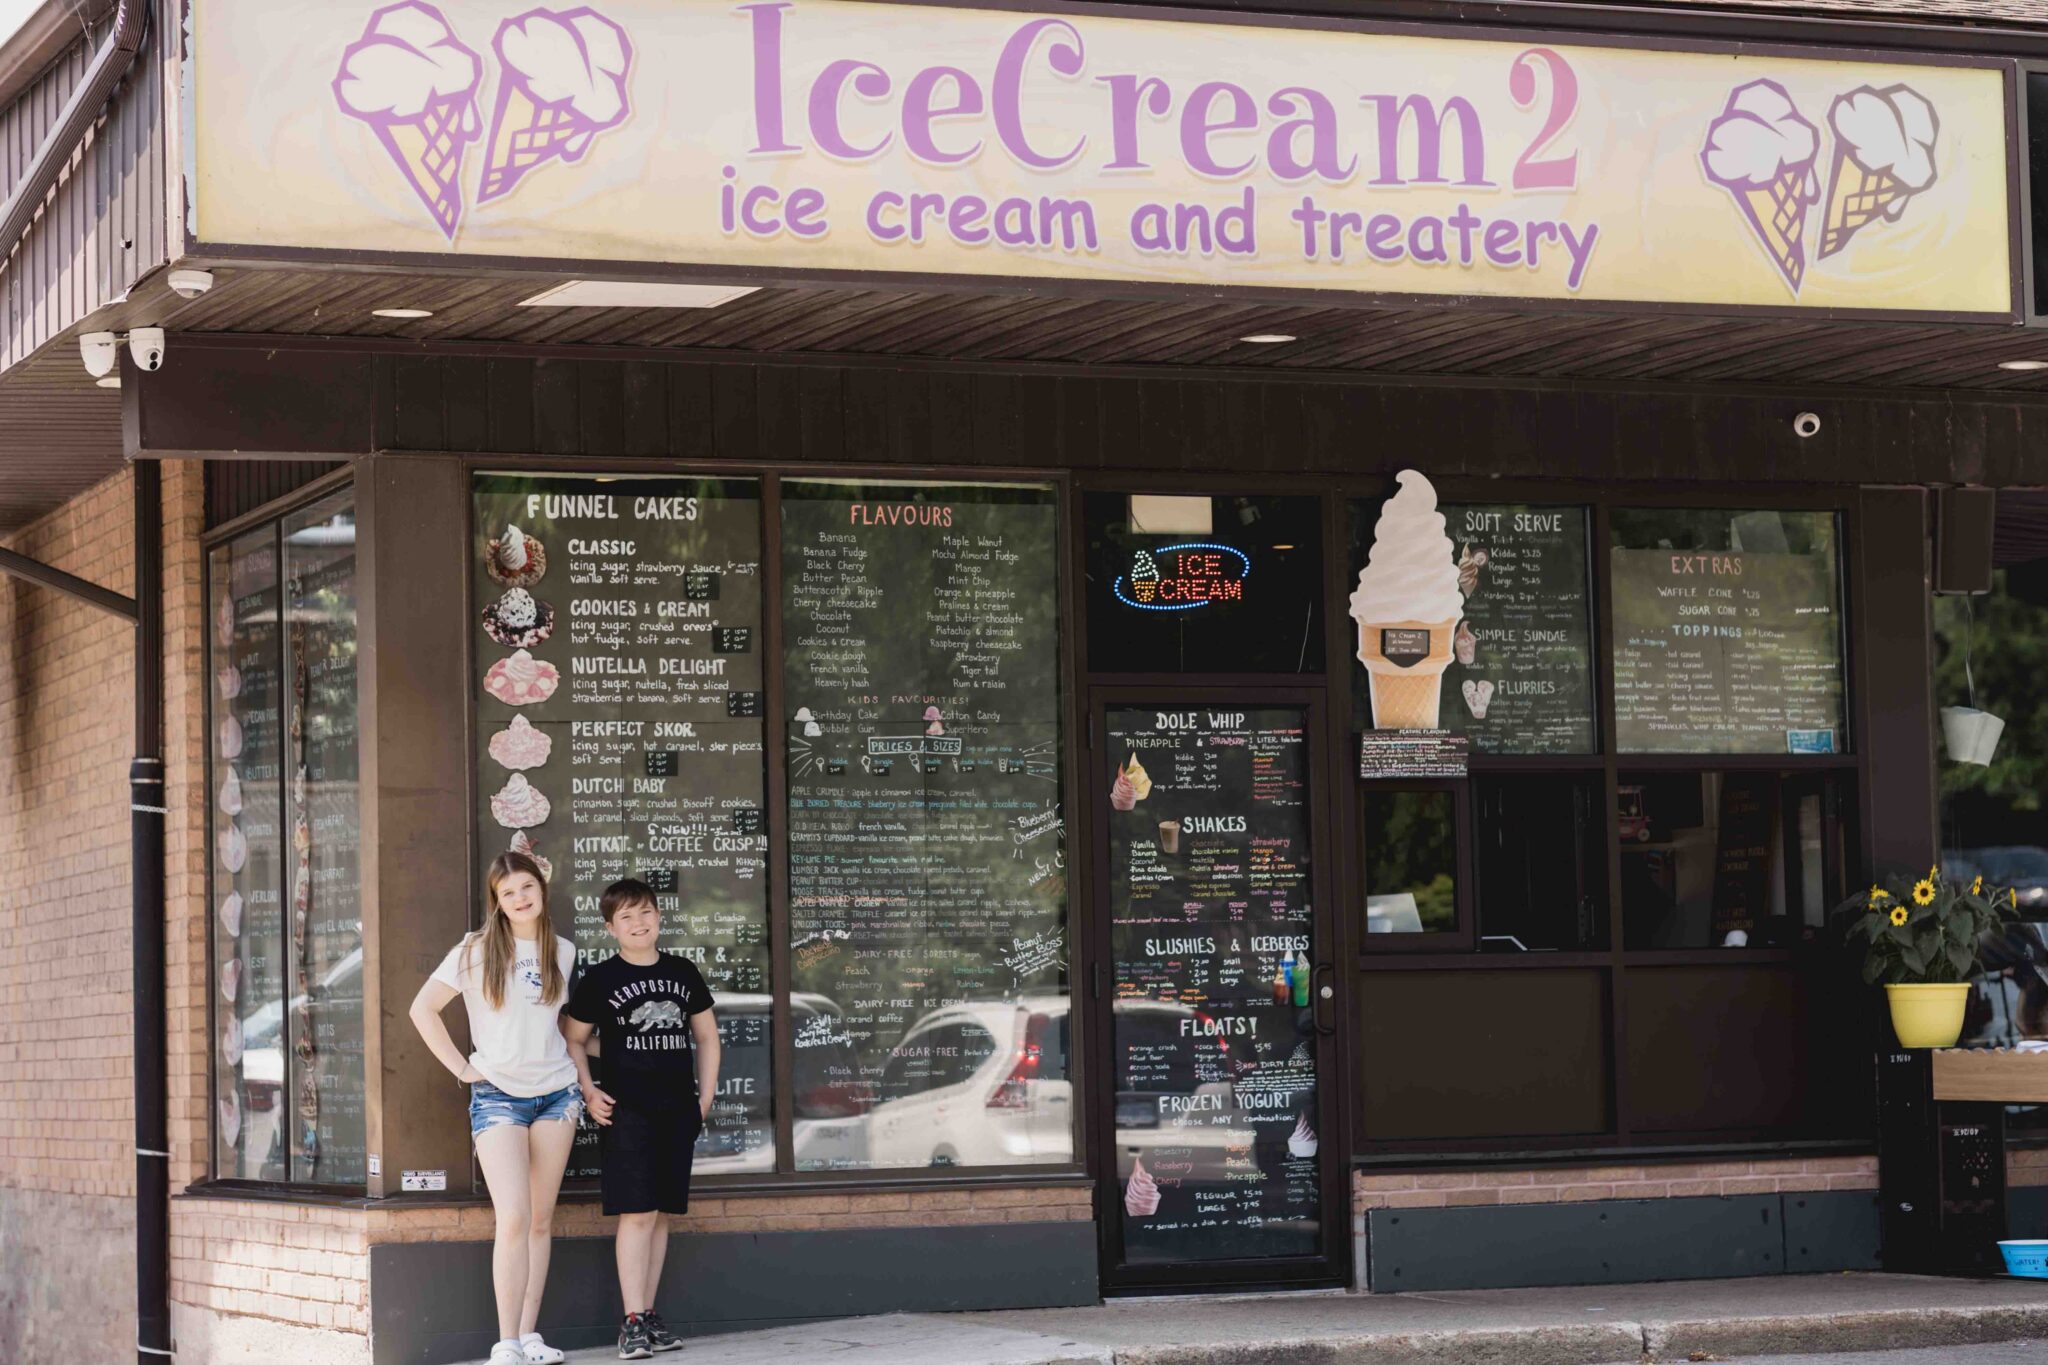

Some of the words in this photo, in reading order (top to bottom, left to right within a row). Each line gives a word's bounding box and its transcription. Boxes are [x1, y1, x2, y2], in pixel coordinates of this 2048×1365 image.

[721, 167, 826, 236] ice
[866, 186, 1097, 249] cream
[1132, 188, 1256, 253] and
[1294, 197, 1599, 290] treatery
[527, 494, 618, 519] FUNNEL
[635, 496, 697, 520] CAKES
[851, 505, 952, 526] FLAVOURS
[1466, 511, 1501, 531] SOFT
[1514, 514, 1561, 531] SERVE
[819, 532, 856, 542] Banana
[943, 536, 969, 547] Maple
[568, 539, 636, 555] CLASSIC
[803, 547, 836, 556] Banana
[843, 547, 868, 558] Fudge
[932, 550, 956, 559] Mocha
[961, 550, 989, 560] Almond
[995, 552, 1019, 563] Fudge
[1491, 549, 1516, 558] Kiddie
[570, 560, 596, 577] icing
[636, 562, 685, 576] strawberry
[807, 560, 831, 569] Black
[838, 561, 864, 572] Cherry
[956, 564, 981, 575] Mango
[1179, 555, 1221, 575] ICE
[1489, 562, 1516, 573] Regular
[1672, 556, 1742, 575] EXTRAS
[570, 574, 602, 584] vanilla
[610, 573, 628, 584] soft
[803, 573, 834, 582] Butter
[841, 574, 867, 582] Pecan
[948, 576, 968, 585] Mint
[973, 577, 990, 588] Chip
[794, 585, 850, 594] Butterscotch
[858, 586, 883, 597] Ripple
[934, 588, 962, 599] Orange
[975, 590, 1015, 600] pineapple
[1159, 579, 1241, 600] CREAM
[1658, 587, 1696, 597] WAFFLE
[1709, 588, 1732, 598] CONE
[570, 600, 637, 616] COOKIES
[644, 604, 650, 615] &
[657, 601, 710, 617] CREAM
[794, 599, 821, 610] Cherry
[827, 599, 877, 609] cheesecake
[940, 600, 970, 609] Pralines
[983, 602, 1009, 610] cream
[1679, 605, 1711, 615] SUGAR
[1718, 606, 1736, 615] CONE
[811, 611, 852, 621] Chocolate
[927, 613, 950, 622] Peanut
[956, 614, 981, 623] butter
[986, 614, 1023, 623] chocolate
[571, 620, 595, 635] icing
[640, 621, 674, 631] crushed
[816, 624, 850, 633] Coconut
[936, 626, 970, 635] Pistachio
[985, 627, 1013, 636] almond
[1673, 625, 1742, 637] TOPPINGS
[571, 633, 588, 643] hot
[637, 634, 658, 645] soft
[1475, 629, 1516, 640] SIMPLE
[1524, 630, 1567, 642] SUNDAE
[798, 637, 827, 646] Cookies
[840, 638, 865, 646] cream
[930, 639, 969, 650] Raspberry
[976, 641, 1022, 650] cheesecake
[812, 651, 839, 660] Cookie
[843, 651, 866, 662] dough
[956, 653, 999, 664] Strawberry
[572, 657, 646, 673] NUTELLA
[659, 659, 726, 675] DELIGHT
[811, 664, 837, 673] French
[961, 666, 981, 676] Tiger
[985, 666, 998, 675] tail
[573, 679, 597, 692] icing
[677, 680, 698, 690] fresh
[703, 681, 729, 690] sliced
[815, 679, 848, 690] Heavenly
[852, 679, 869, 687] hash
[953, 679, 971, 688] Rum
[1498, 680, 1555, 695] FLURRIES
[572, 694, 621, 704] strawberries
[673, 694, 691, 703] soft
[848, 696, 878, 704] KIDS
[813, 710, 850, 720] Birthday
[858, 711, 878, 719] Cake
[941, 710, 969, 719] Cotton
[978, 710, 1000, 722] Candy
[1156, 712, 1197, 729] DOLE
[1209, 713, 1245, 728] WHIP
[572, 722, 644, 736] PERFECT
[820, 724, 850, 733] Bubble
[857, 724, 875, 732] Gum
[572, 740, 598, 753] icing
[644, 741, 657, 751] hot
[871, 741, 912, 751] PRICES
[933, 741, 960, 751] SIZES
[1126, 738, 1181, 748] PINEAPPLE
[573, 755, 591, 764] soft
[1175, 764, 1196, 774] Regular
[1176, 774, 1192, 782] Large
[572, 779, 624, 794] DUTCH
[634, 779, 666, 793] BABY
[573, 799, 612, 808] cinnamon
[647, 799, 677, 808] crushed
[683, 798, 714, 808] Biscoff
[573, 813, 588, 823] hot
[630, 813, 648, 822] sliced
[688, 813, 704, 822] soft
[1017, 808, 1055, 829] Blueberry
[859, 822, 881, 831] french
[1182, 816, 1246, 833] SHAKES
[1014, 817, 1064, 844] Cheesecake
[650, 837, 703, 851] COFFEE
[575, 858, 596, 871] icing
[698, 858, 728, 866] crushed
[575, 872, 593, 881] soft
[691, 915, 708, 927] pure
[714, 913, 745, 921] Canadian
[694, 927, 710, 935] soft
[1013, 932, 1042, 951] Peanut
[1146, 937, 1215, 956] SLUSHIES
[1231, 938, 1240, 952] &
[1251, 936, 1309, 952] ICEBERGS
[708, 968, 733, 980] fudge
[845, 966, 870, 975] Peach
[627, 1035, 686, 1050] CALIFORNIA
[829, 1067, 852, 1076] Black
[1159, 1095, 1222, 1113] FROZEN
[1236, 1092, 1292, 1108] YOGURT
[714, 1116, 748, 1125] vanilla
[1211, 1116, 1232, 1124] ANY
[1195, 1192, 1236, 1200] REGULAR
